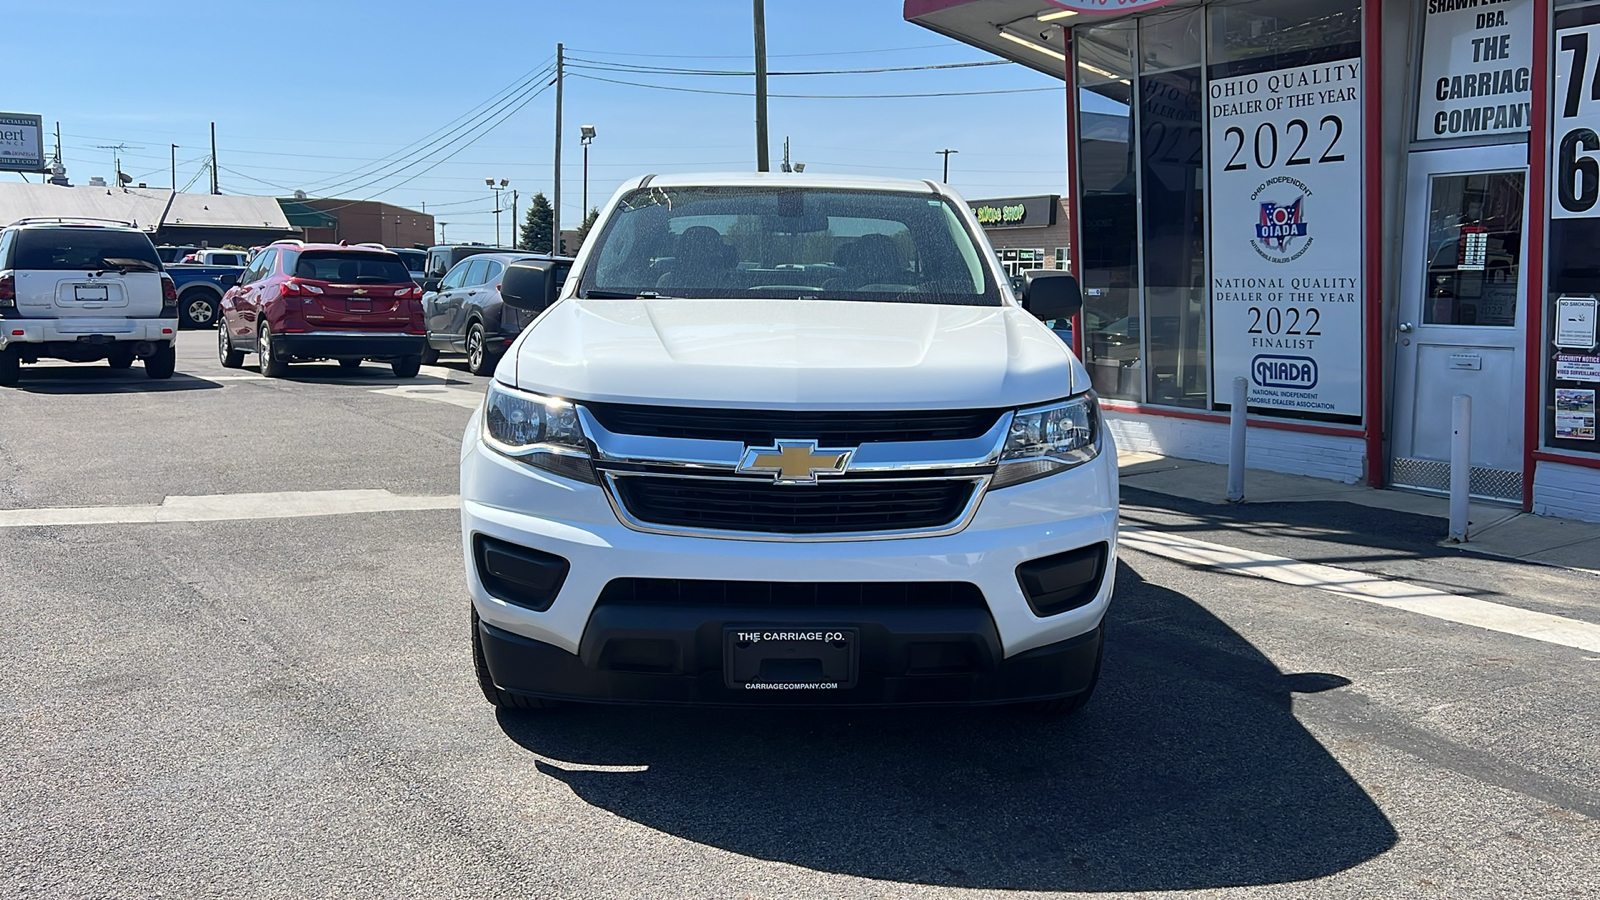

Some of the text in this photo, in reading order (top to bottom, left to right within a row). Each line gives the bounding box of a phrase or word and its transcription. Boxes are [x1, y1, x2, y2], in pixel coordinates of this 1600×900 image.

[1475, 10, 1509, 30] DBA.
[1471, 34, 1511, 63] THE
[1210, 62, 1360, 99] OHIO QUALITY
[1435, 67, 1532, 101] CARRIAG
[1213, 99, 1263, 118] DEALER
[1266, 96, 1284, 112] OF
[1287, 92, 1315, 108] THE
[1318, 86, 1357, 105] YEAR
[1223, 114, 1346, 172] 2022
[1250, 175, 1313, 201] OHIO INDEPENDENT
[1002, 203, 1025, 221] SHOP
[1261, 223, 1299, 237] OIADA
[1250, 236, 1314, 264] AUTOMOBILE DEALERS ASSOCIATION
[1214, 277, 1358, 291] NATIONAL QUALITY
[1216, 292, 1355, 303] DEALER OF THE YEAR
[1247, 306, 1322, 336] 2022
[1252, 337, 1315, 350] FINALIST
[1558, 354, 1582, 362] SECURITY
[1256, 361, 1312, 383] NIADA
[1247, 396, 1336, 410] OMOBILE DEALERS ASSOCIATION
[1252, 389, 1319, 400] NATIONAL INDEPENDENT
[737, 632, 845, 641] THE CARRIAGE CO.
[745, 682, 838, 690] CARRIAGECOMPANY.COM
